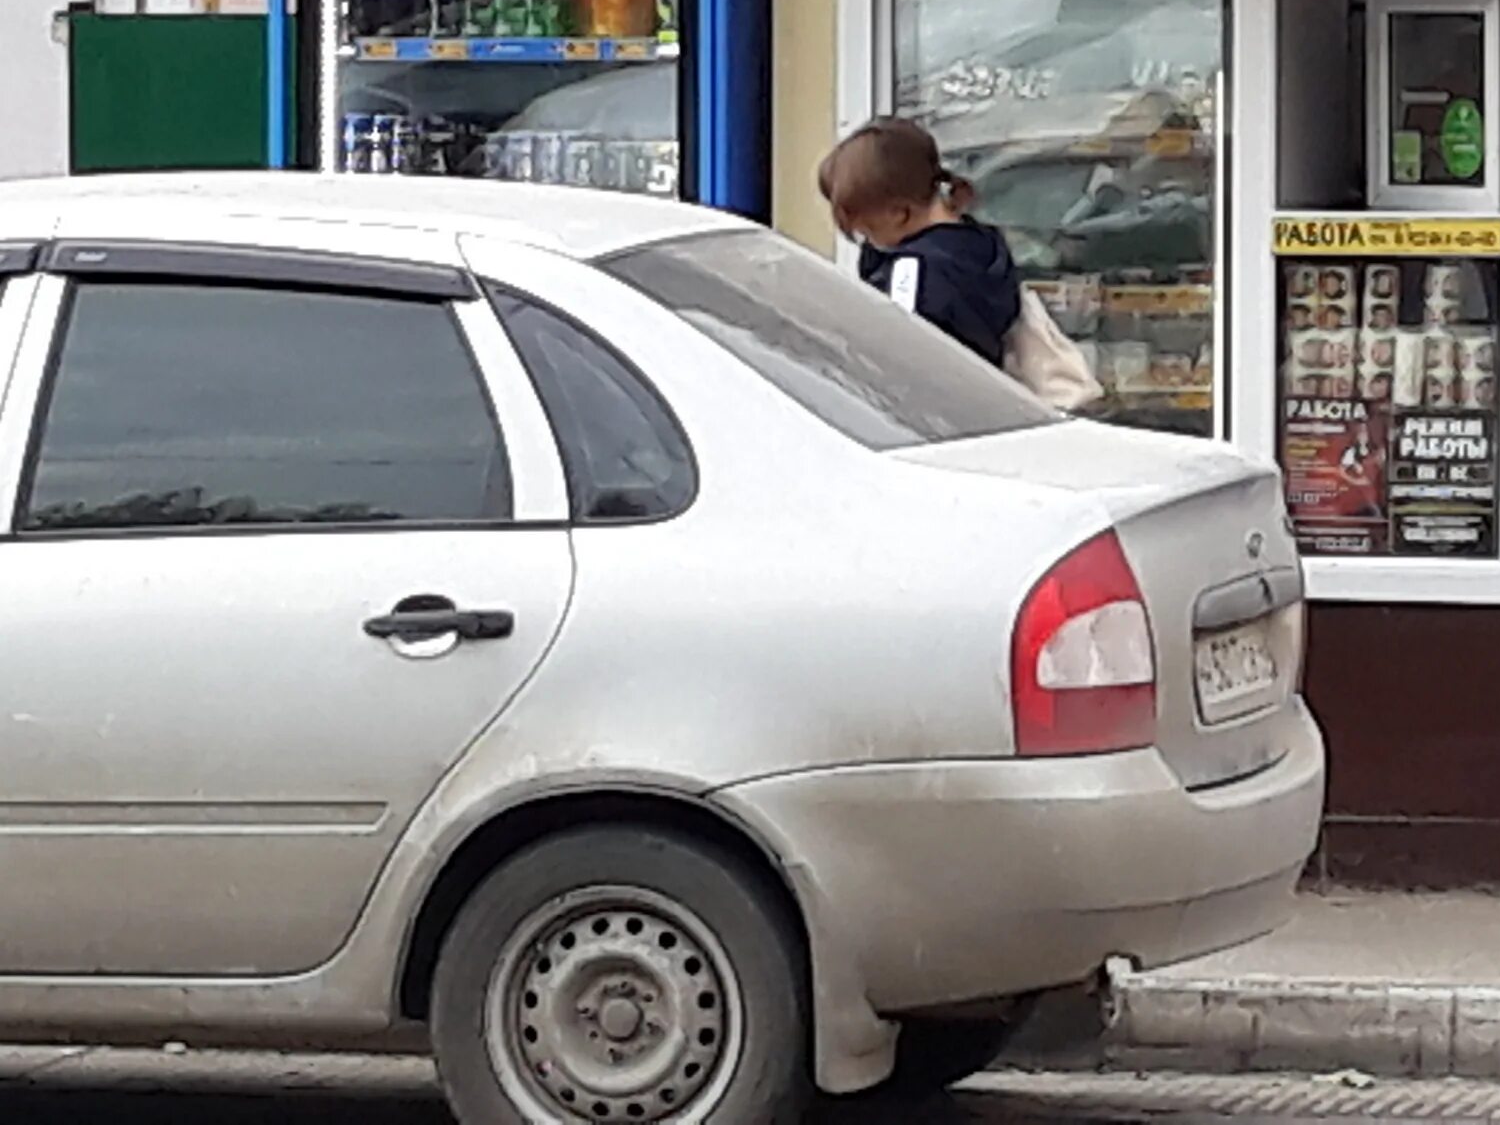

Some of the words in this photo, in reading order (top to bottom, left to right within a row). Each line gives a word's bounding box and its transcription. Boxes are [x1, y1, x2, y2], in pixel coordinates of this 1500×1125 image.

[1275, 221, 1365, 247] РАБОТА
[1285, 399, 1368, 421] РАБОТА
[1399, 437, 1489, 460] РАБОТЫ
